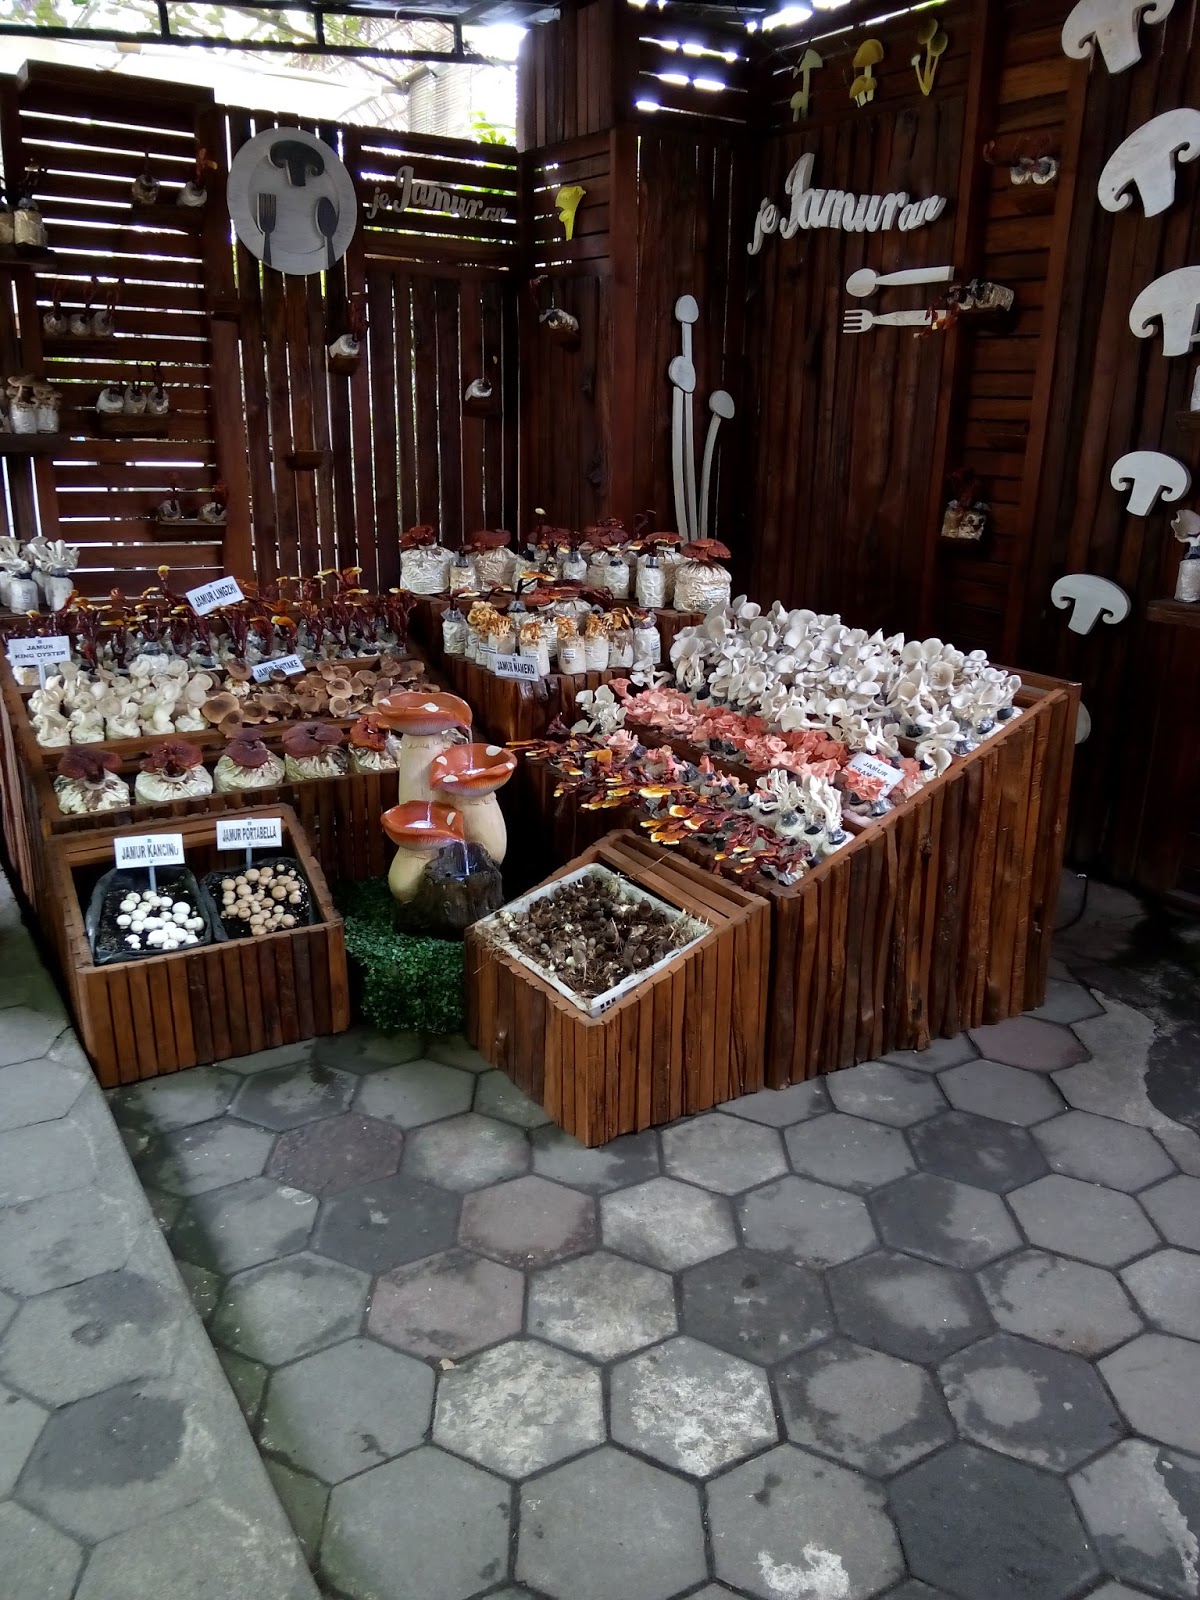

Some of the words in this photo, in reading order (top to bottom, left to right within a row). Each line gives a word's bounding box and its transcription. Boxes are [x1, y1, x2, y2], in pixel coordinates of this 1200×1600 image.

[195, 591, 216, 607] JAMUR
[213, 583, 238, 600] LINGZHI
[37, 650, 66, 658] OYSTER
[497, 660, 513, 672] JAMUR
[863, 762, 888, 777] JAMUR
[222, 828, 242, 842] JAMUR
[242, 825, 277, 840] PORTABELLA
[122, 844, 147, 860] JAMUR
